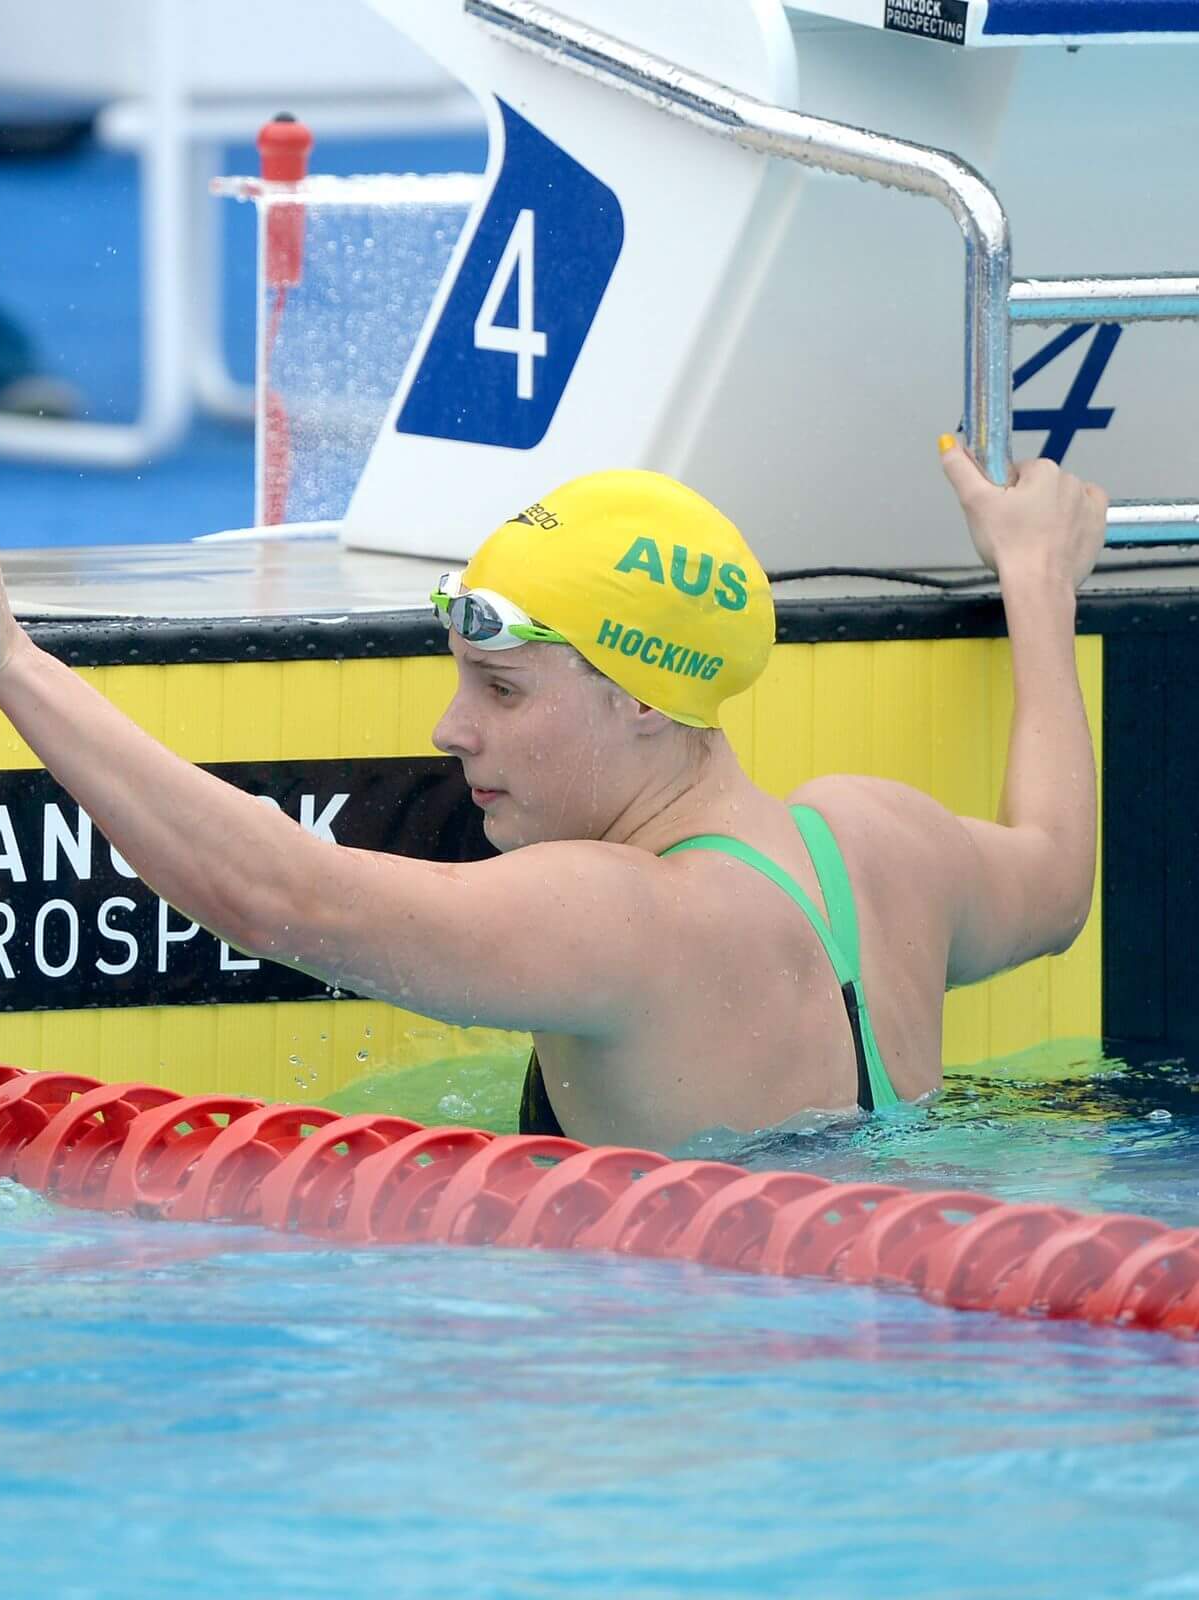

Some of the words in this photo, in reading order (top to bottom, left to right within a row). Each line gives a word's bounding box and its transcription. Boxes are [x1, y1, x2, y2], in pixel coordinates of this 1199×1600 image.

[886, 8, 963, 39] PROSPECTING
[474, 208, 547, 400] 4
[957, 322, 1123, 465] 4
[614, 536, 748, 612] AUS
[596, 619, 724, 681] HOCKING
